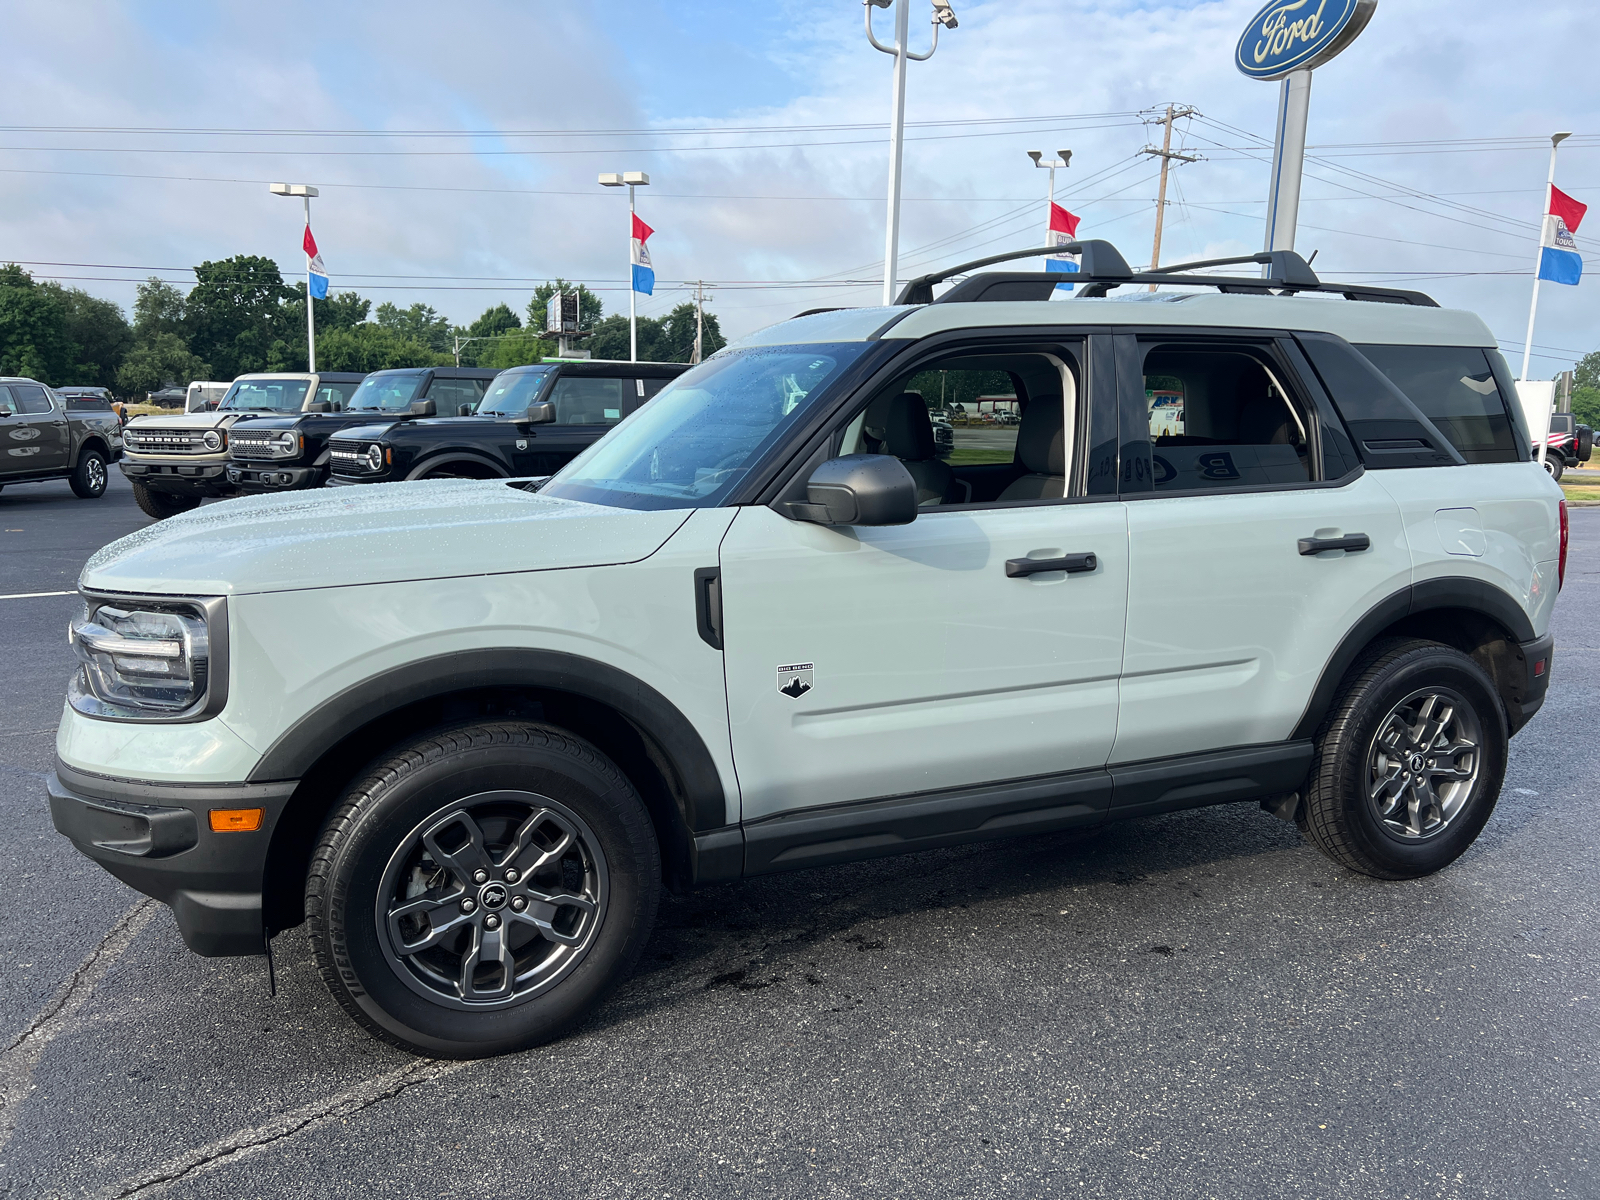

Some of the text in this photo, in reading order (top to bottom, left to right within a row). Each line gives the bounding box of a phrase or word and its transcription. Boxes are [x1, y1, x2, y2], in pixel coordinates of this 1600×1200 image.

[1254, 0, 1323, 63] Ford
[330, 874, 347, 926] PAW
[332, 943, 366, 998] TIGER
